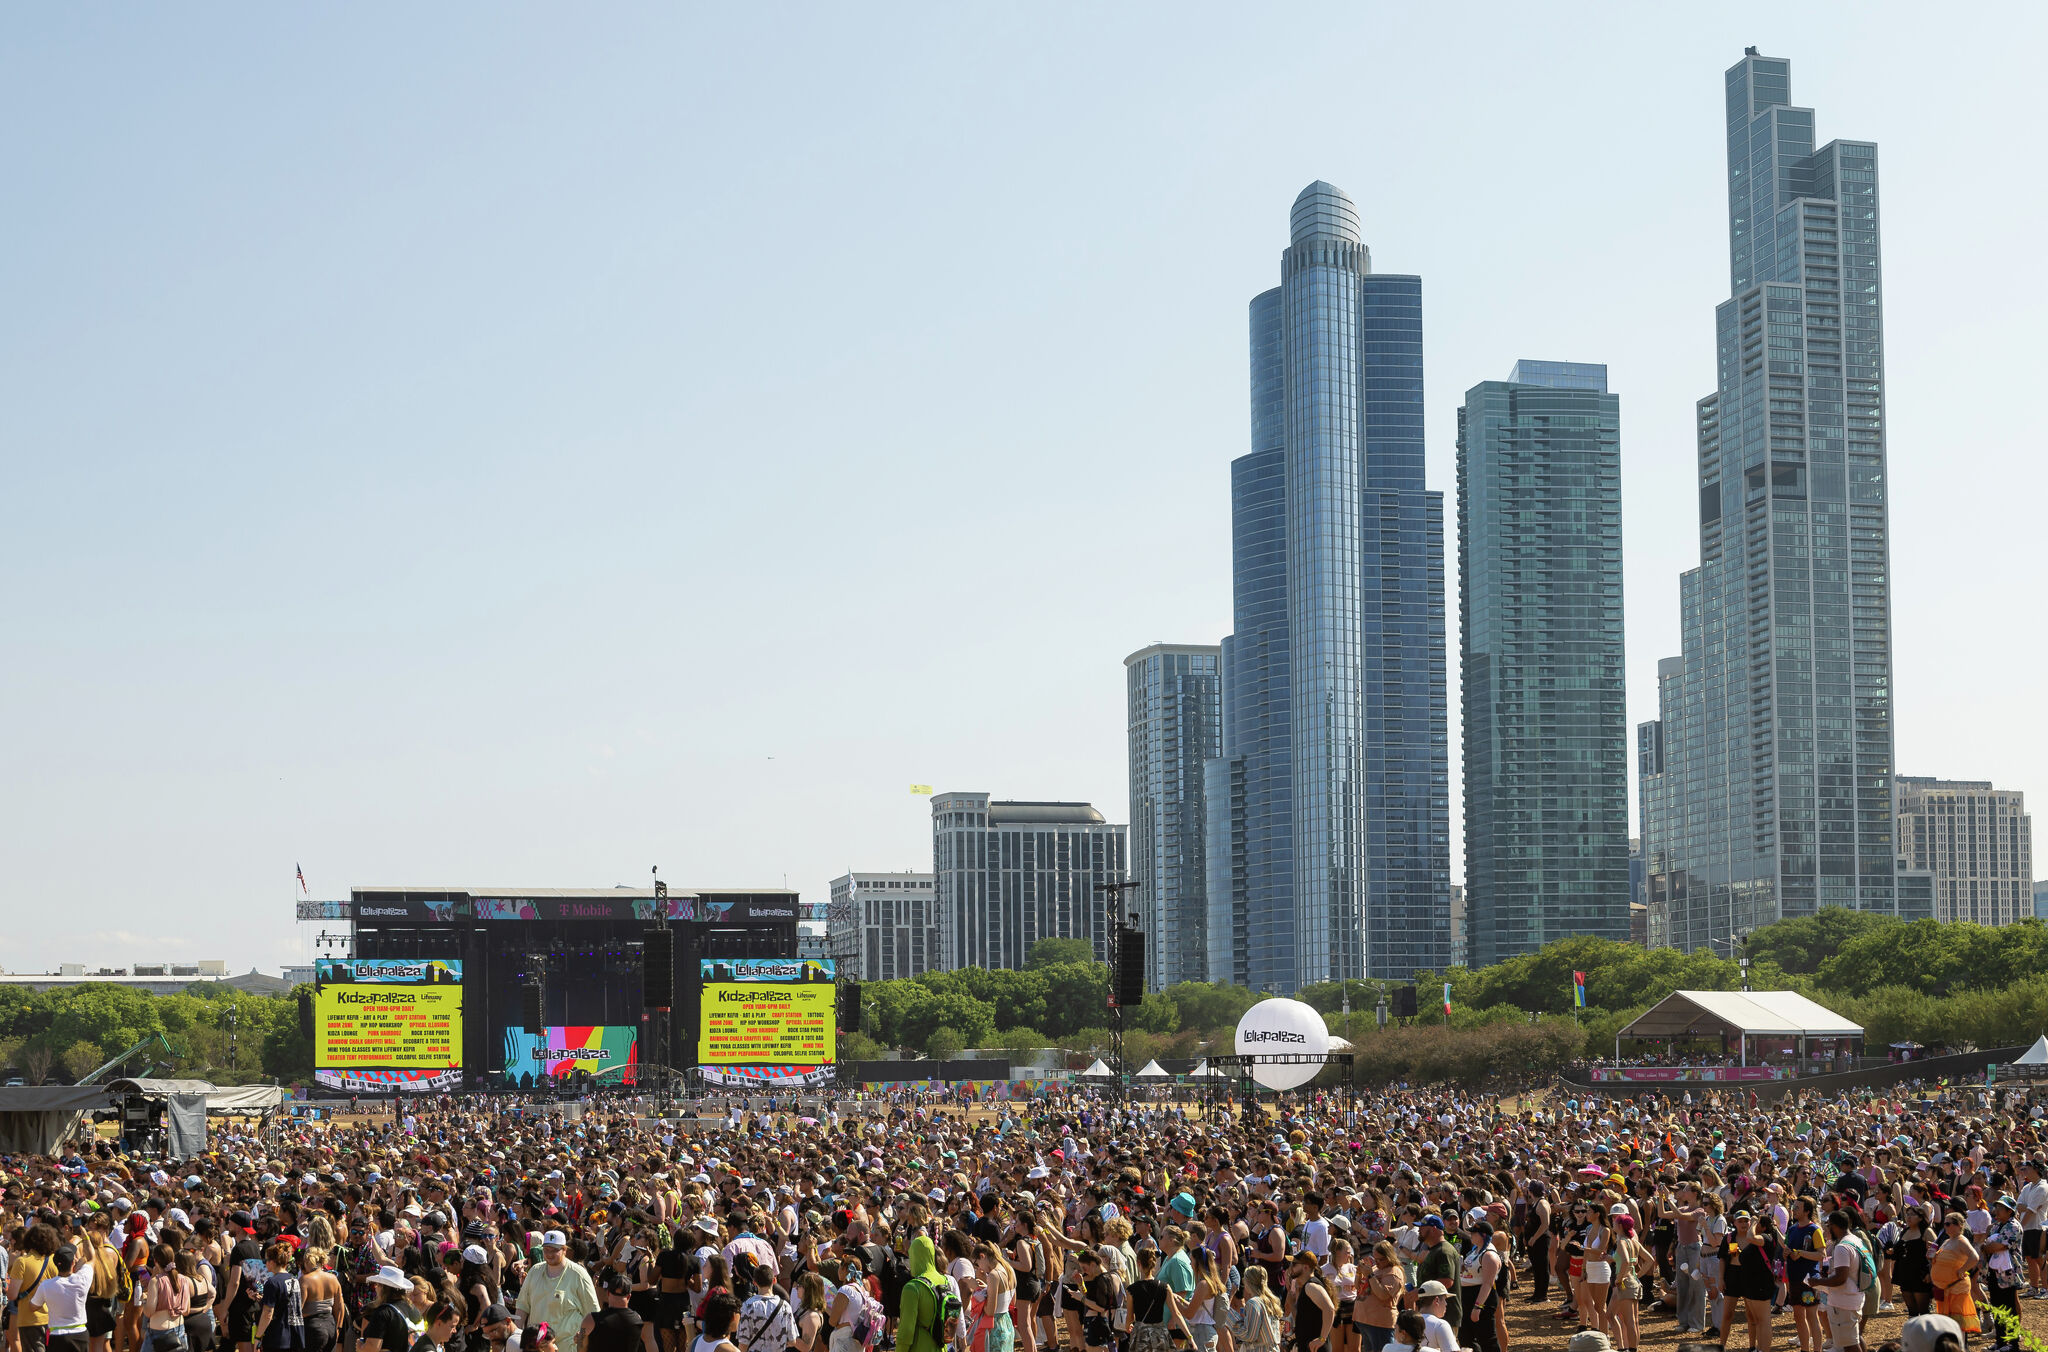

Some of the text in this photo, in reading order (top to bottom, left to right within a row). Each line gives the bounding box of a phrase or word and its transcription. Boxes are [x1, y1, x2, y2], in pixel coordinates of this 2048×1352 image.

[360, 906, 408, 916] Lollapalooza
[560, 904, 612, 916] T Mobile
[749, 908, 794, 917] Lollapalooza
[356, 964, 423, 977] Lollapalooza
[736, 964, 798, 976] Lollapalooza
[338, 992, 416, 1004] Kidzapalooza
[718, 990, 792, 1002] Kidzapalooza
[1244, 1029, 1306, 1043] Lollapalooza
